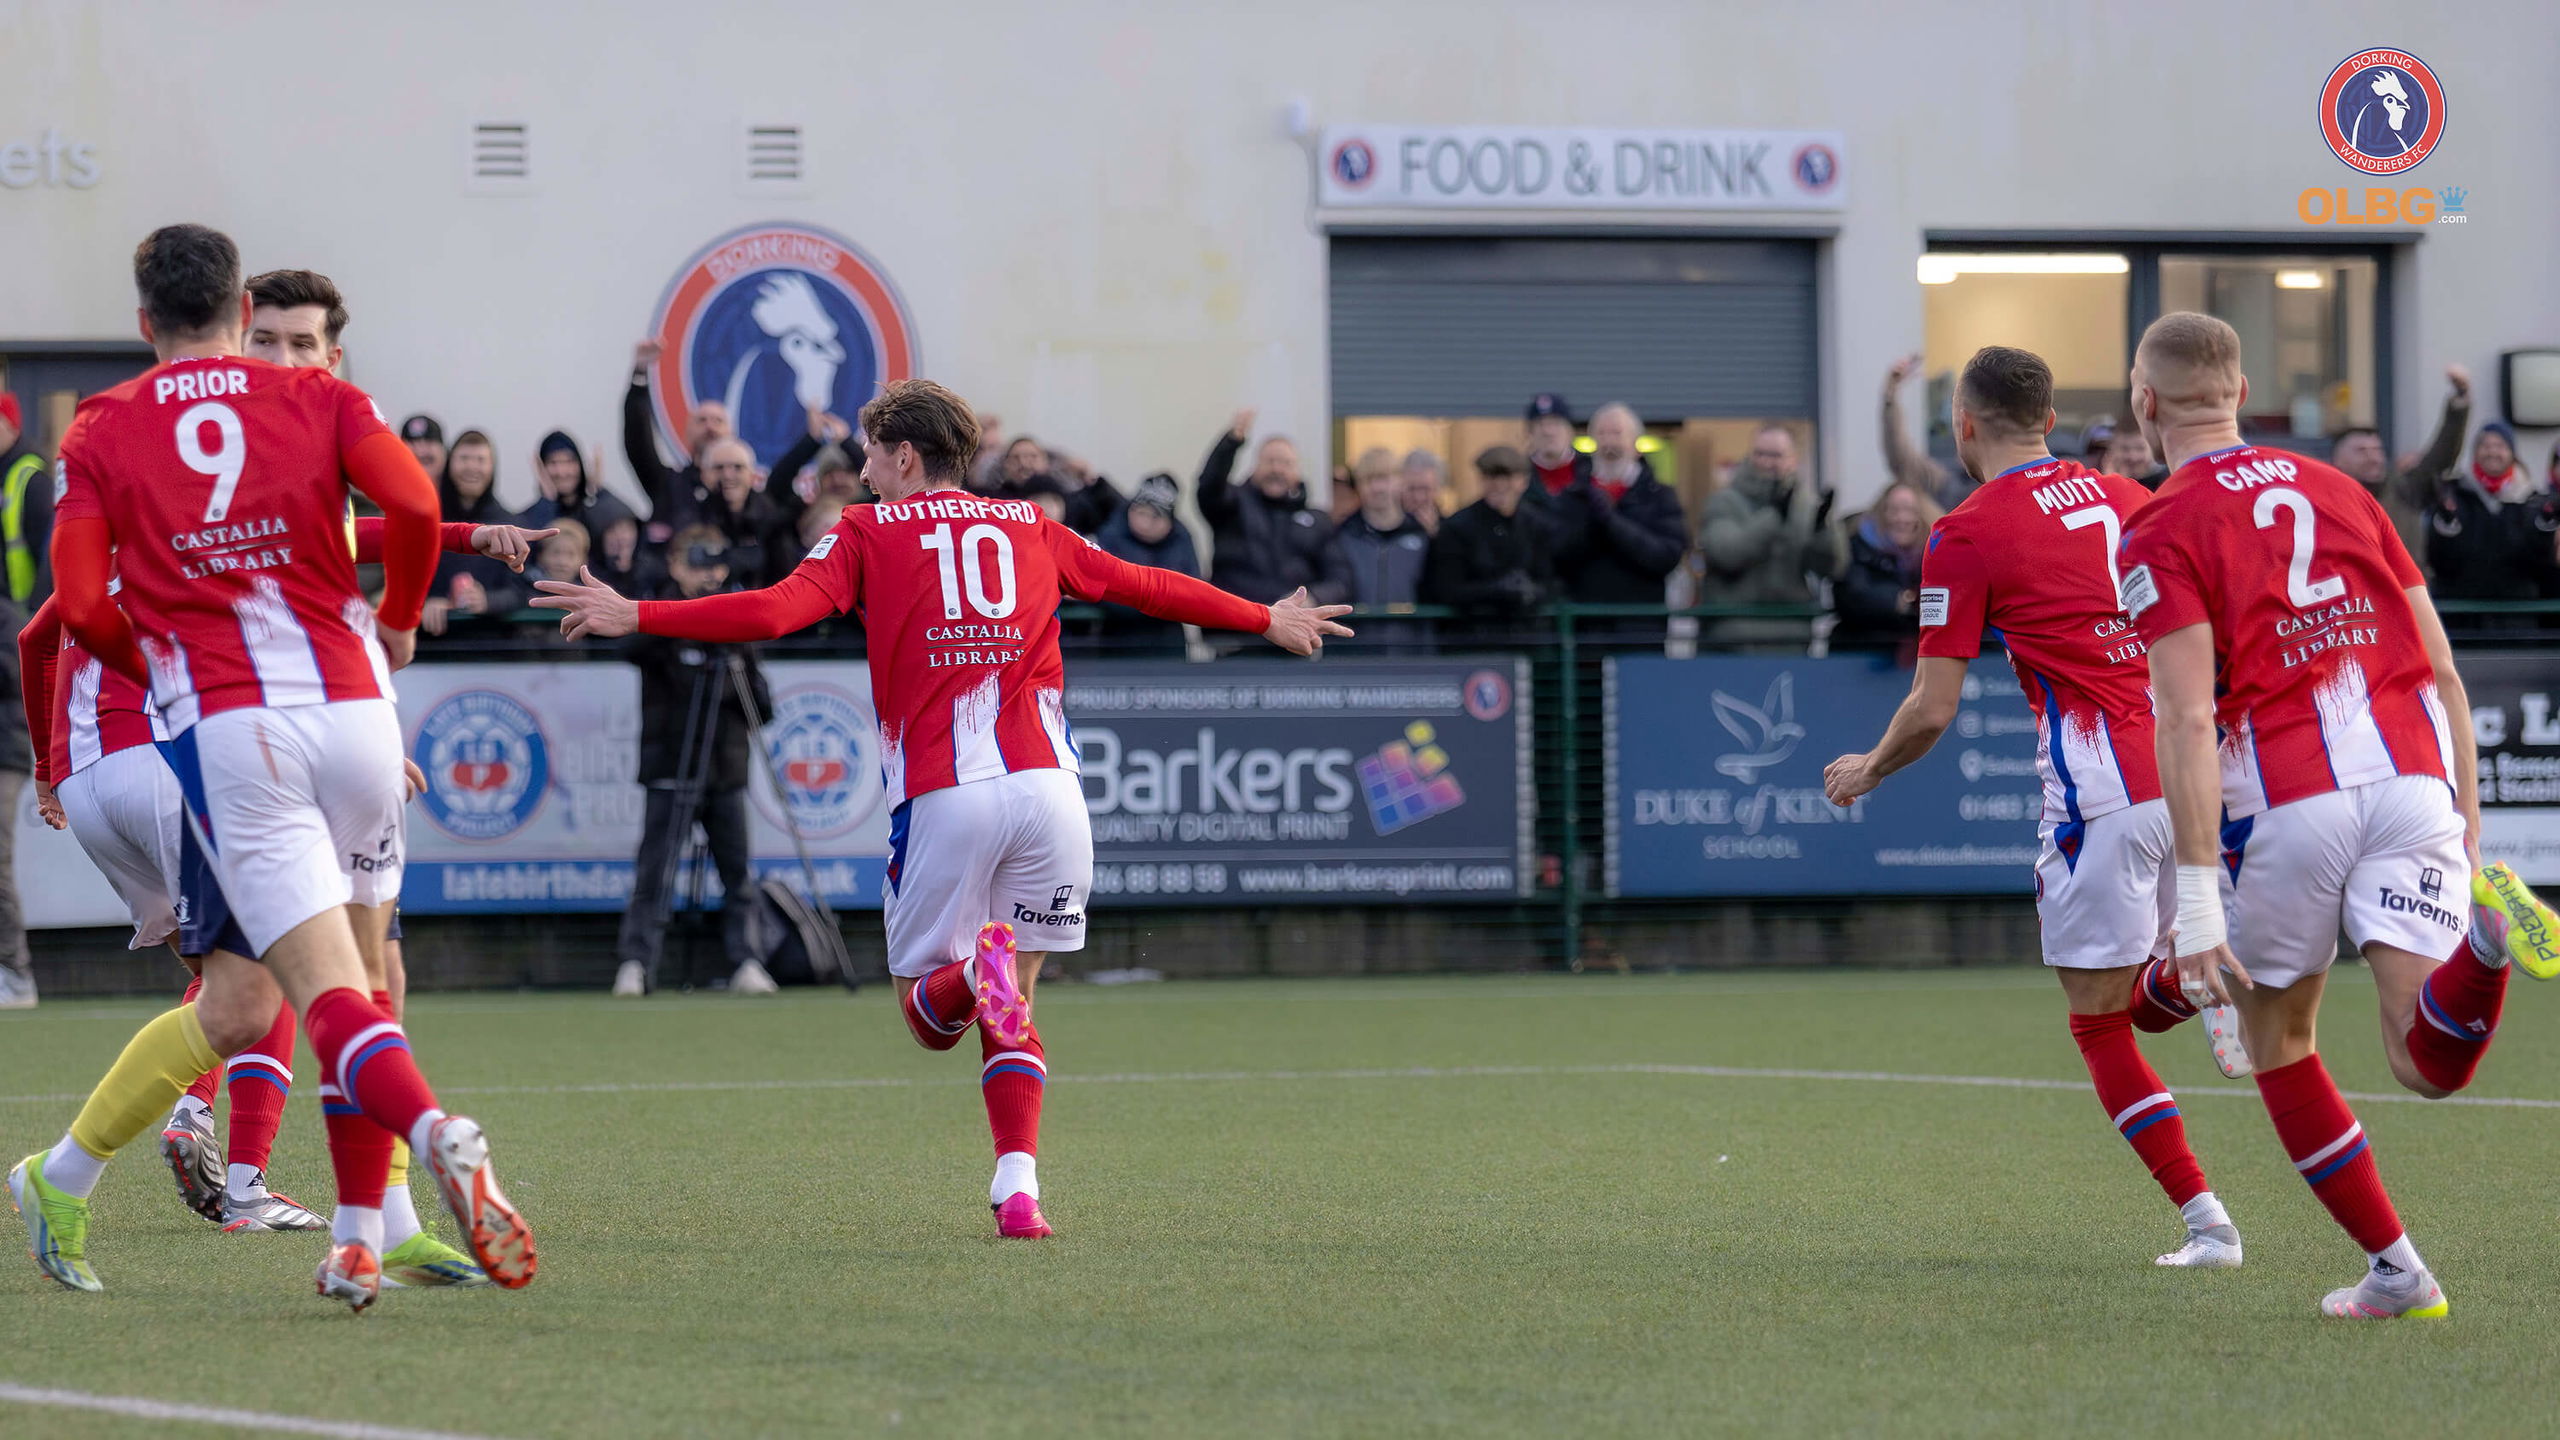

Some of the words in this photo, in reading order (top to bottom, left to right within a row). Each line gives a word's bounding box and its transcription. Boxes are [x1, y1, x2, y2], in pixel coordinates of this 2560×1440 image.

[1401, 137, 1552, 195] FOOD
[1564, 138, 1602, 196] &
[1614, 139, 1773, 197] DRINK
[704, 235, 842, 281] DORKING
[156, 370, 249, 404] PRIOR
[176, 402, 246, 523] 9
[2215, 459, 2298, 491] CAMP
[874, 499, 1037, 525] RUTHERFORD
[2031, 476, 2107, 515] MUITT
[171, 517, 289, 551] CASTALIA
[2253, 488, 2346, 608] 2
[181, 548, 293, 580] LIBRARY
[920, 523, 1016, 620] 10
[2060, 504, 2128, 612] 7
[926, 625, 1024, 641] CASTALIA
[2276, 596, 2375, 637] CASTALIA
[928, 649, 1025, 667] LIBRARY
[2281, 627, 2379, 668] LIBRARY
[1072, 727, 1355, 814] Barkers
[1178, 813, 1277, 842] DIGITAL
[1277, 811, 1353, 841] PRINT
[1635, 788, 1733, 825] DUKE
[1734, 784, 1777, 835] of
[1774, 788, 1866, 824] KENT
[1703, 834, 1802, 859] SCHOOL
[1013, 902, 1081, 926] Taverns
[2379, 887, 2459, 931] Taverns
